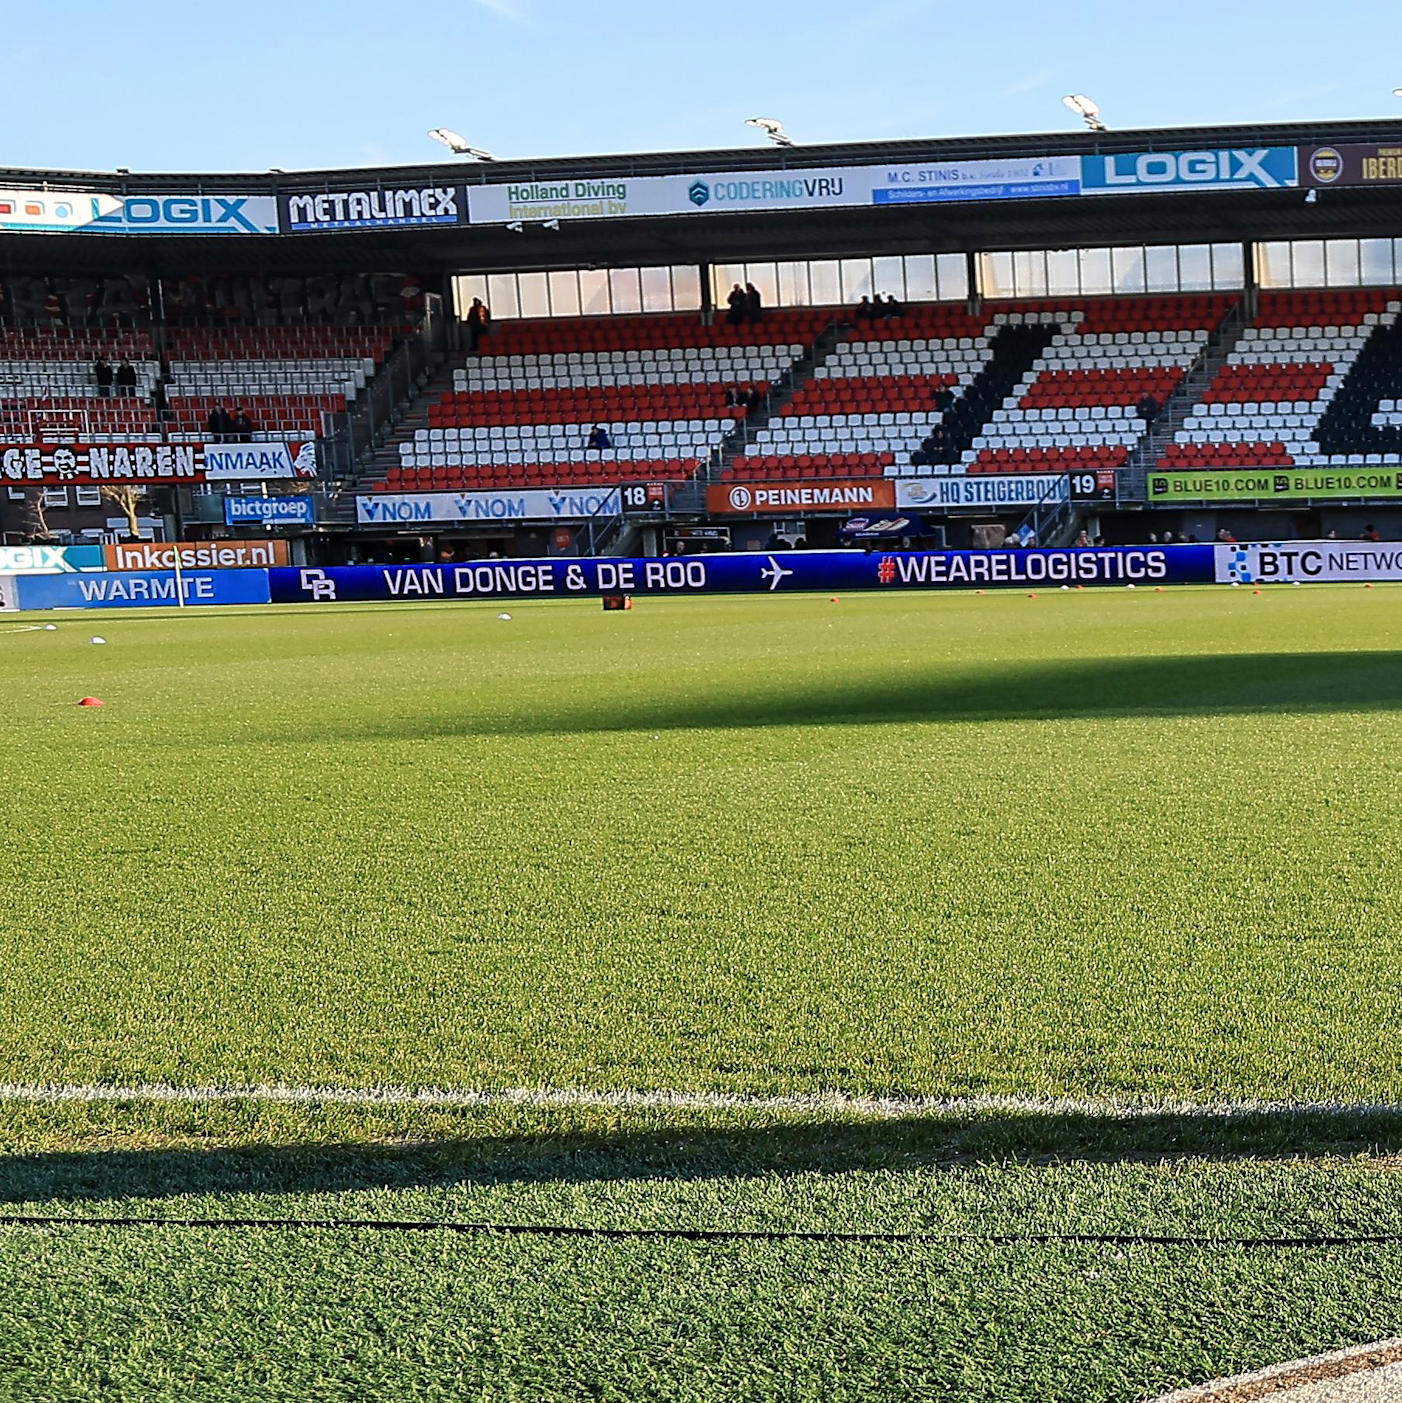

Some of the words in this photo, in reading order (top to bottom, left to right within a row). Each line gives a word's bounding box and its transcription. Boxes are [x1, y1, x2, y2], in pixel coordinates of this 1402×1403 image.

[919, 169, 959, 182] STINIS
[1104, 149, 1274, 185] LOGIX
[507, 184, 570, 201] Holland
[574, 180, 627, 200] Diving
[289, 187, 458, 223] METALIMEX
[509, 201, 602, 219] International
[89, 446, 195, 478] NAREN
[940, 481, 960, 503] HQ
[1072, 475, 1095, 493] 19
[1173, 478, 1268, 493] BLUE10.COM
[1295, 475, 1391, 490] BLUE10.COM
[624, 487, 646, 505] 18
[755, 487, 873, 506] PEINEMANN
[231, 498, 307, 519] bictgroep
[0, 547, 77, 572] GIX
[878, 551, 1166, 583] #WEARELOGISTICS
[1259, 551, 1322, 576] BTC
[384, 568, 443, 594] VAN
[455, 565, 554, 592] DONGE
[566, 564, 587, 590] &
[597, 563, 635, 589] DE
[646, 561, 706, 588] ROO
[79, 578, 214, 601] WARMTE
